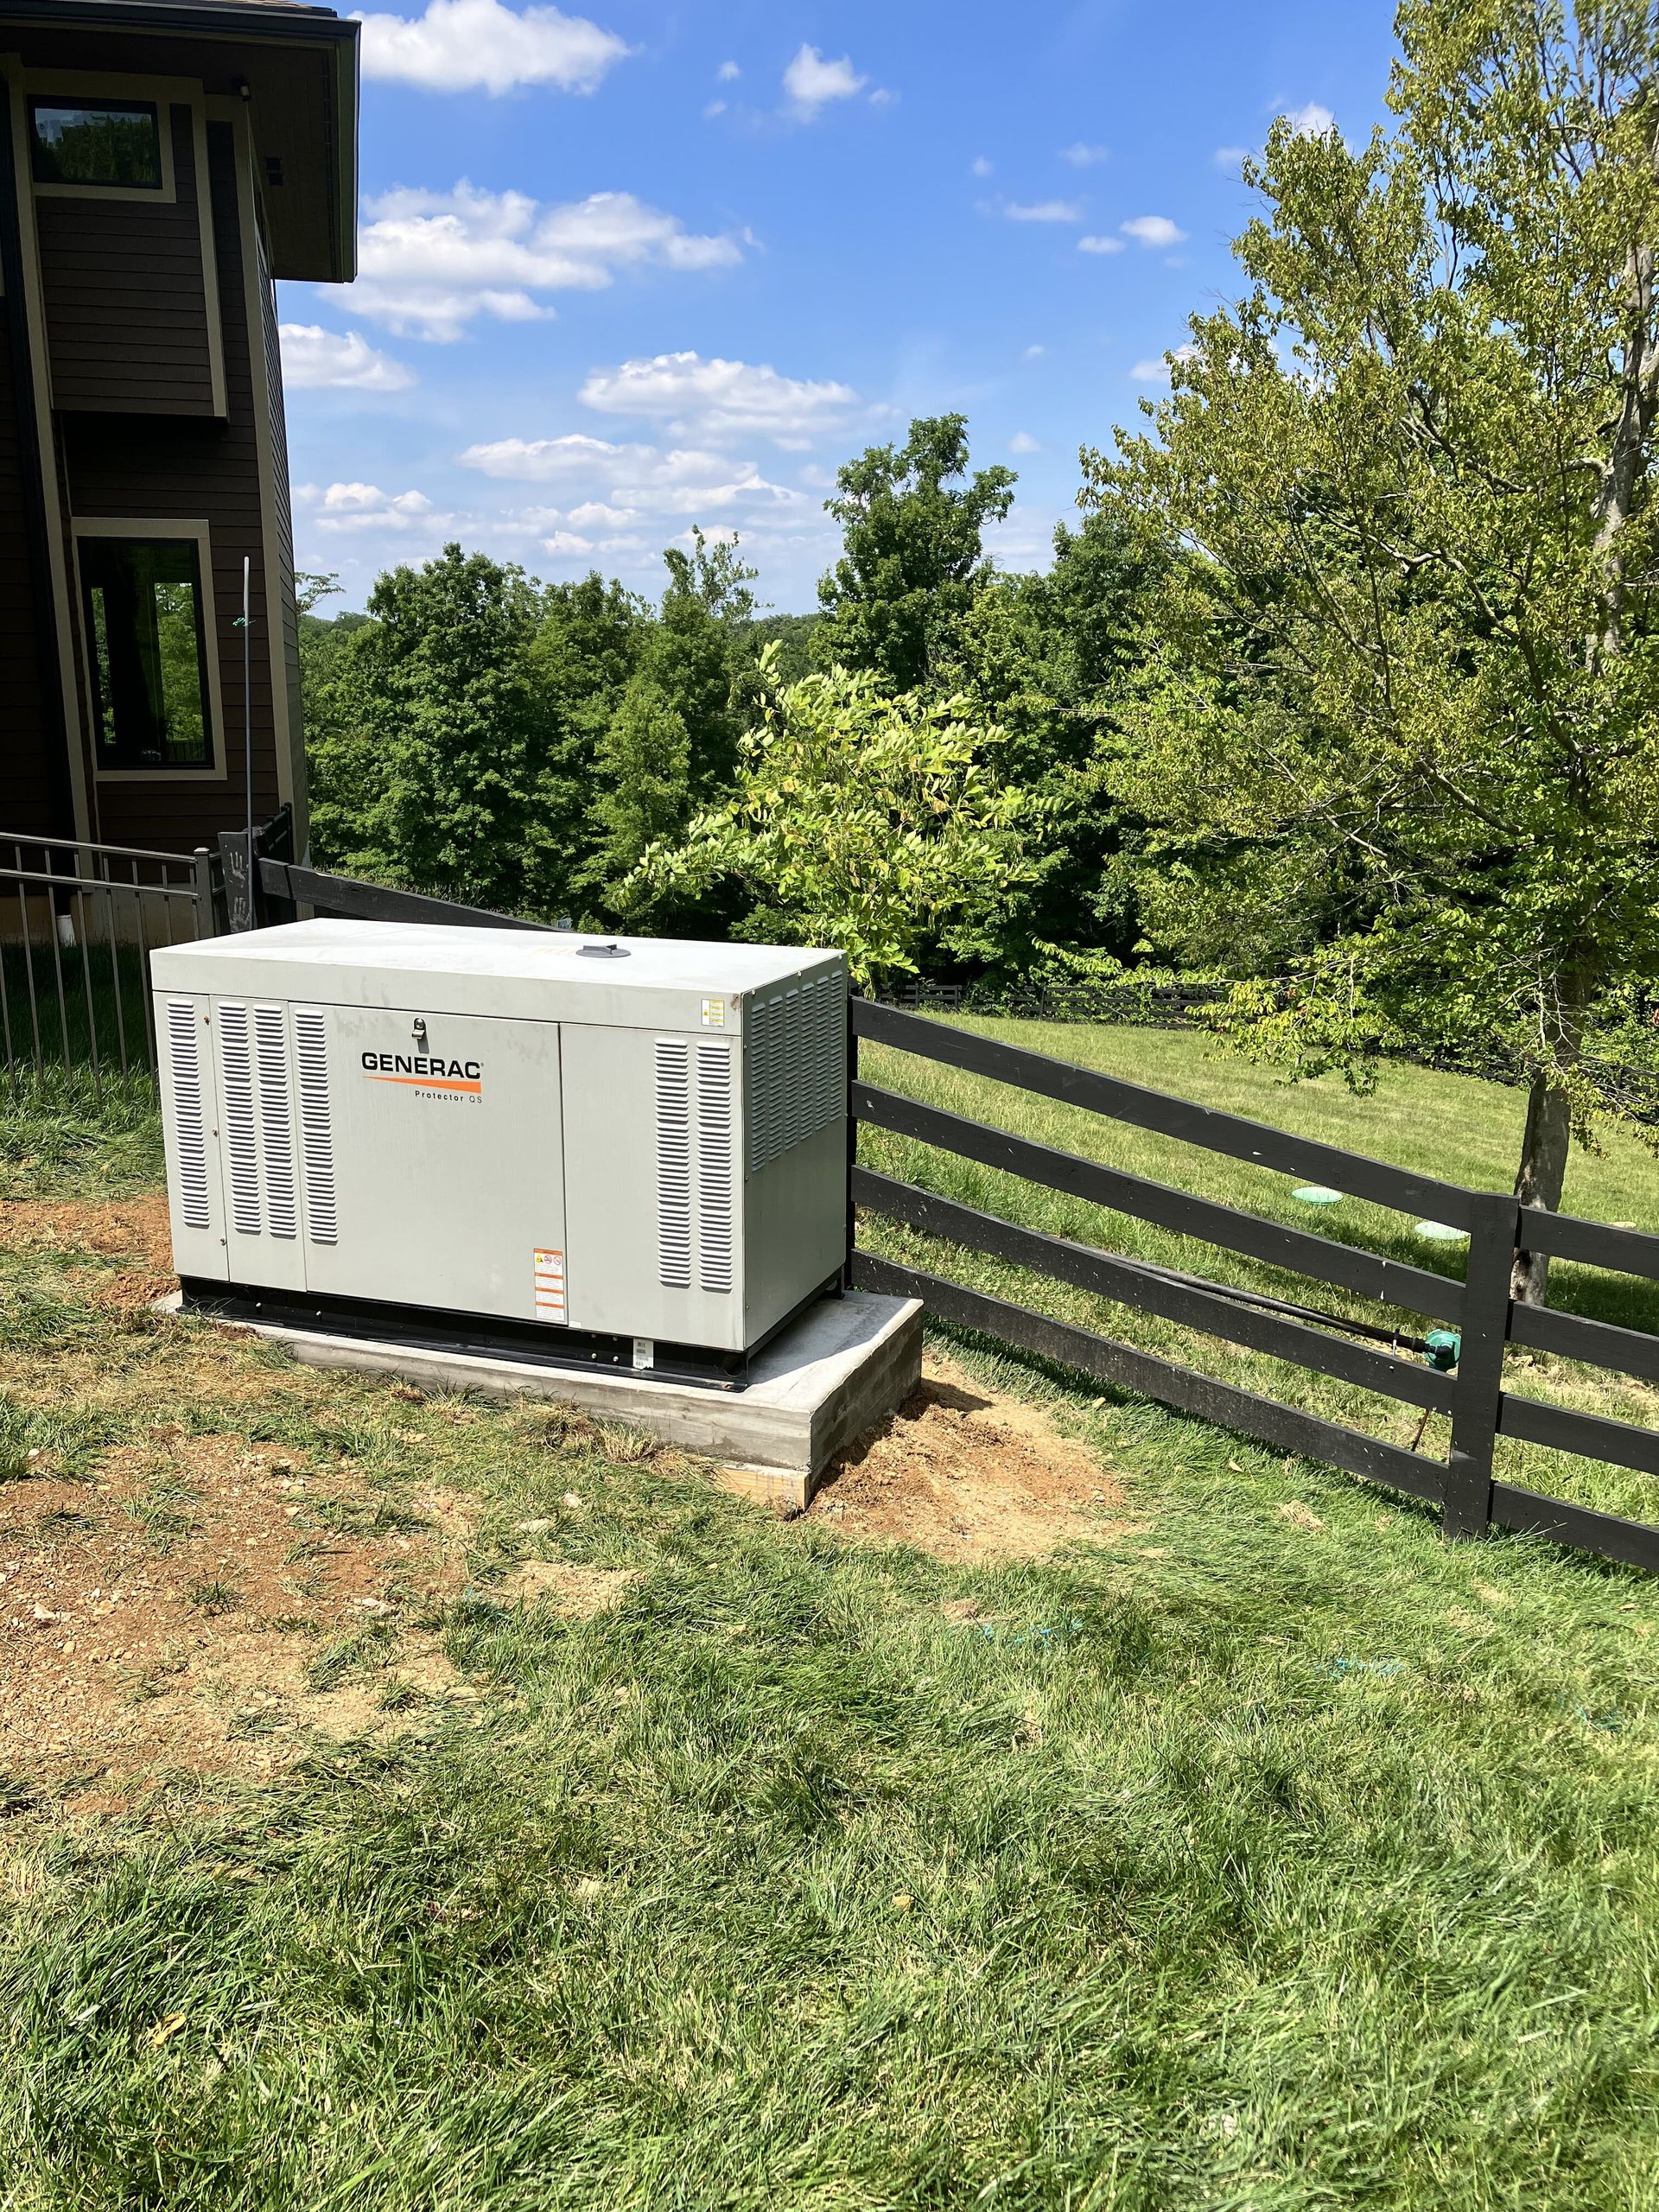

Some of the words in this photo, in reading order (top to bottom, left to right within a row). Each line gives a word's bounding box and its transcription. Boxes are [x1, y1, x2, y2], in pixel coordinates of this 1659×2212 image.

[361, 1052, 481, 1079] GENERAC
[415, 1090, 464, 1102] Protector
[469, 1095, 483, 1103] QS
